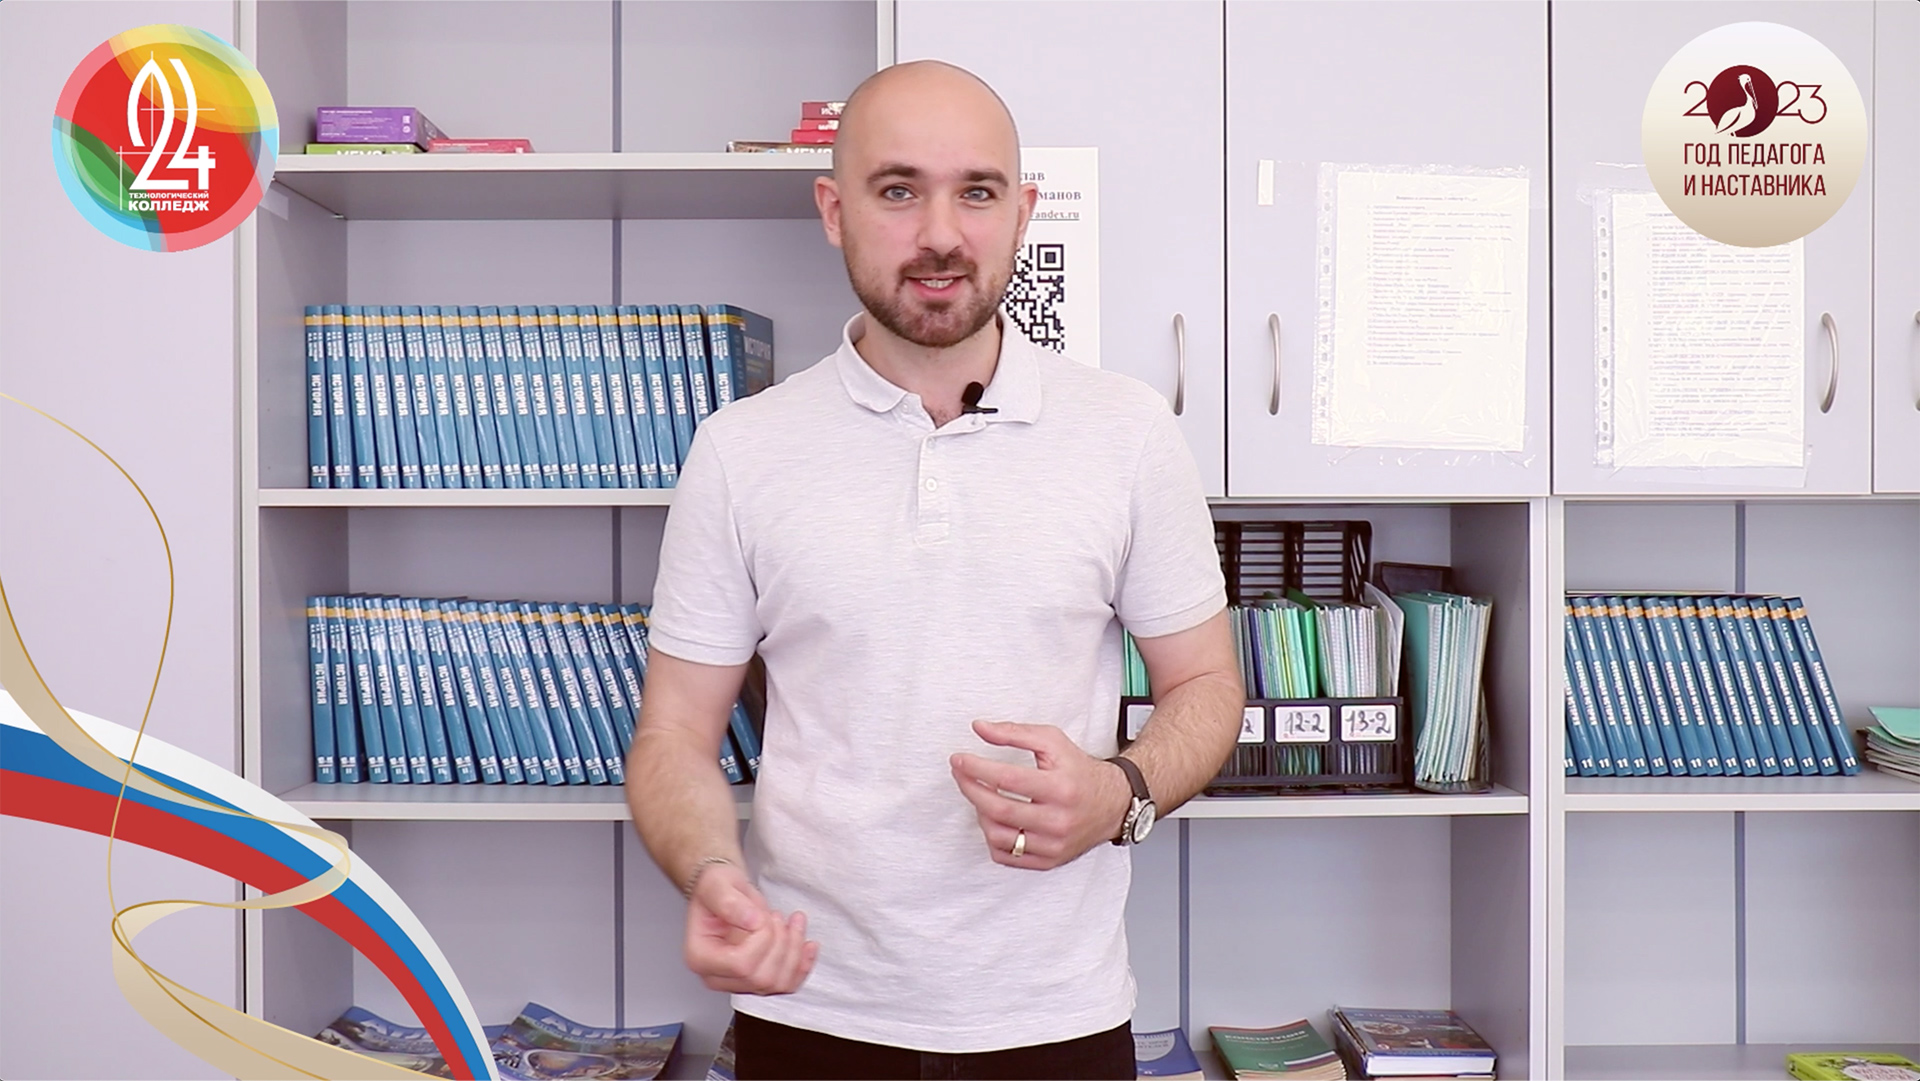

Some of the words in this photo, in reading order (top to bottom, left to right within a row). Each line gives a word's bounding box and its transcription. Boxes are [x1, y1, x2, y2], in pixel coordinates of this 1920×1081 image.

[312, 375, 322, 416] ИСТОРИЯ
[332, 374, 344, 415] ИСТОРИЯ
[354, 375, 366, 416] ИСТОРИЯ
[375, 375, 388, 416] ИСТОРИЯ
[395, 374, 408, 415] ИСТОРИЯ
[415, 374, 429, 415] ИСТОРИЯ
[434, 374, 449, 415] ИСТОРИЯ
[454, 375, 468, 416] ИСТОРИЯ
[474, 374, 488, 415] ИСТОРИЯ
[493, 374, 508, 415] ИСТОРИЯ
[513, 374, 528, 415] ИСТОРИЯ
[532, 374, 547, 415] ИСТОРИЯ
[552, 374, 567, 415] ИСТОРИЯ
[572, 374, 586, 415] ИСТОРИЯ
[590, 374, 605, 415] ИСТОРИЯ
[611, 374, 625, 415] ИСТОРИЯ
[631, 374, 646, 414] ИСТОРИЯ
[651, 374, 665, 415] ИСТОРИЯ
[672, 374, 686, 414] ИСТОРИЯ
[694, 373, 708, 414] ИСТОРИЯ
[315, 664, 326, 704] ИСТОРИЯ
[336, 664, 348, 704] ИСТОРИЯ
[358, 664, 372, 705] ИСТОРИЯ
[378, 665, 392, 705] ИСТОРИЯ
[398, 665, 412, 705] ИСТОРИЯ
[418, 665, 433, 706] ИСТОРИЯ
[438, 666, 455, 706] ИСТОРИЯ
[460, 666, 478, 707] ИСТОРИЯ
[480, 667, 498, 708] ИСТОРИЯ
[501, 667, 519, 708] ИСТОРИЯ
[520, 668, 539, 708] ИСТОРИЯ
[541, 668, 559, 708] ИСТОРИЯ
[561, 668, 579, 709] ИСТОРИЯ
[581, 668, 600, 708] ИСТОРИЯ
[603, 668, 622, 708] ИСТОРИЯ
[1285, 711, 1325, 735] 12-2
[1345, 710, 1392, 736] 13-2
[1584, 696, 1597, 726] ИСТОРИЯ
[1602, 696, 1616, 726] ИСТОРИЯ
[1619, 696, 1632, 726] ИСТОРИЯ
[1638, 696, 1651, 726] ИСТОРИЯ
[1657, 696, 1670, 726] ИСТОРИЯ
[1675, 697, 1689, 726] ИСТОРИЯ
[1691, 696, 1705, 726] ИСТОРИЯ
[1710, 696, 1723, 725] ИСТОРИЯ
[1729, 696, 1743, 725] ИСТОРИЯ
[1748, 696, 1762, 725] ИСТОРИЯ
[1766, 696, 1780, 726] ИСТОРИЯ
[1785, 696, 1799, 726] ИСТОРИЯ
[1804, 696, 1818, 726] ИСТОРИЯ
[1825, 696, 1840, 726] ИСТОРИЯ
[1582, 758, 1592, 768] 11
[1599, 758, 1610, 768] 11
[1617, 758, 1628, 768] 11
[1634, 758, 1645, 768] 11
[1653, 758, 1664, 768] 11
[1672, 758, 1683, 768] 11
[1691, 758, 1701, 768] 11
[1707, 758, 1718, 768] 11
[1726, 758, 1737, 768] 11
[1745, 758, 1756, 768] 11
[1764, 757, 1776, 768] 11
[1783, 758, 1794, 768] 11
[1802, 758, 1814, 768] 11
[1822, 757, 1833, 767] 11
[1845, 757, 1856, 767] 11
